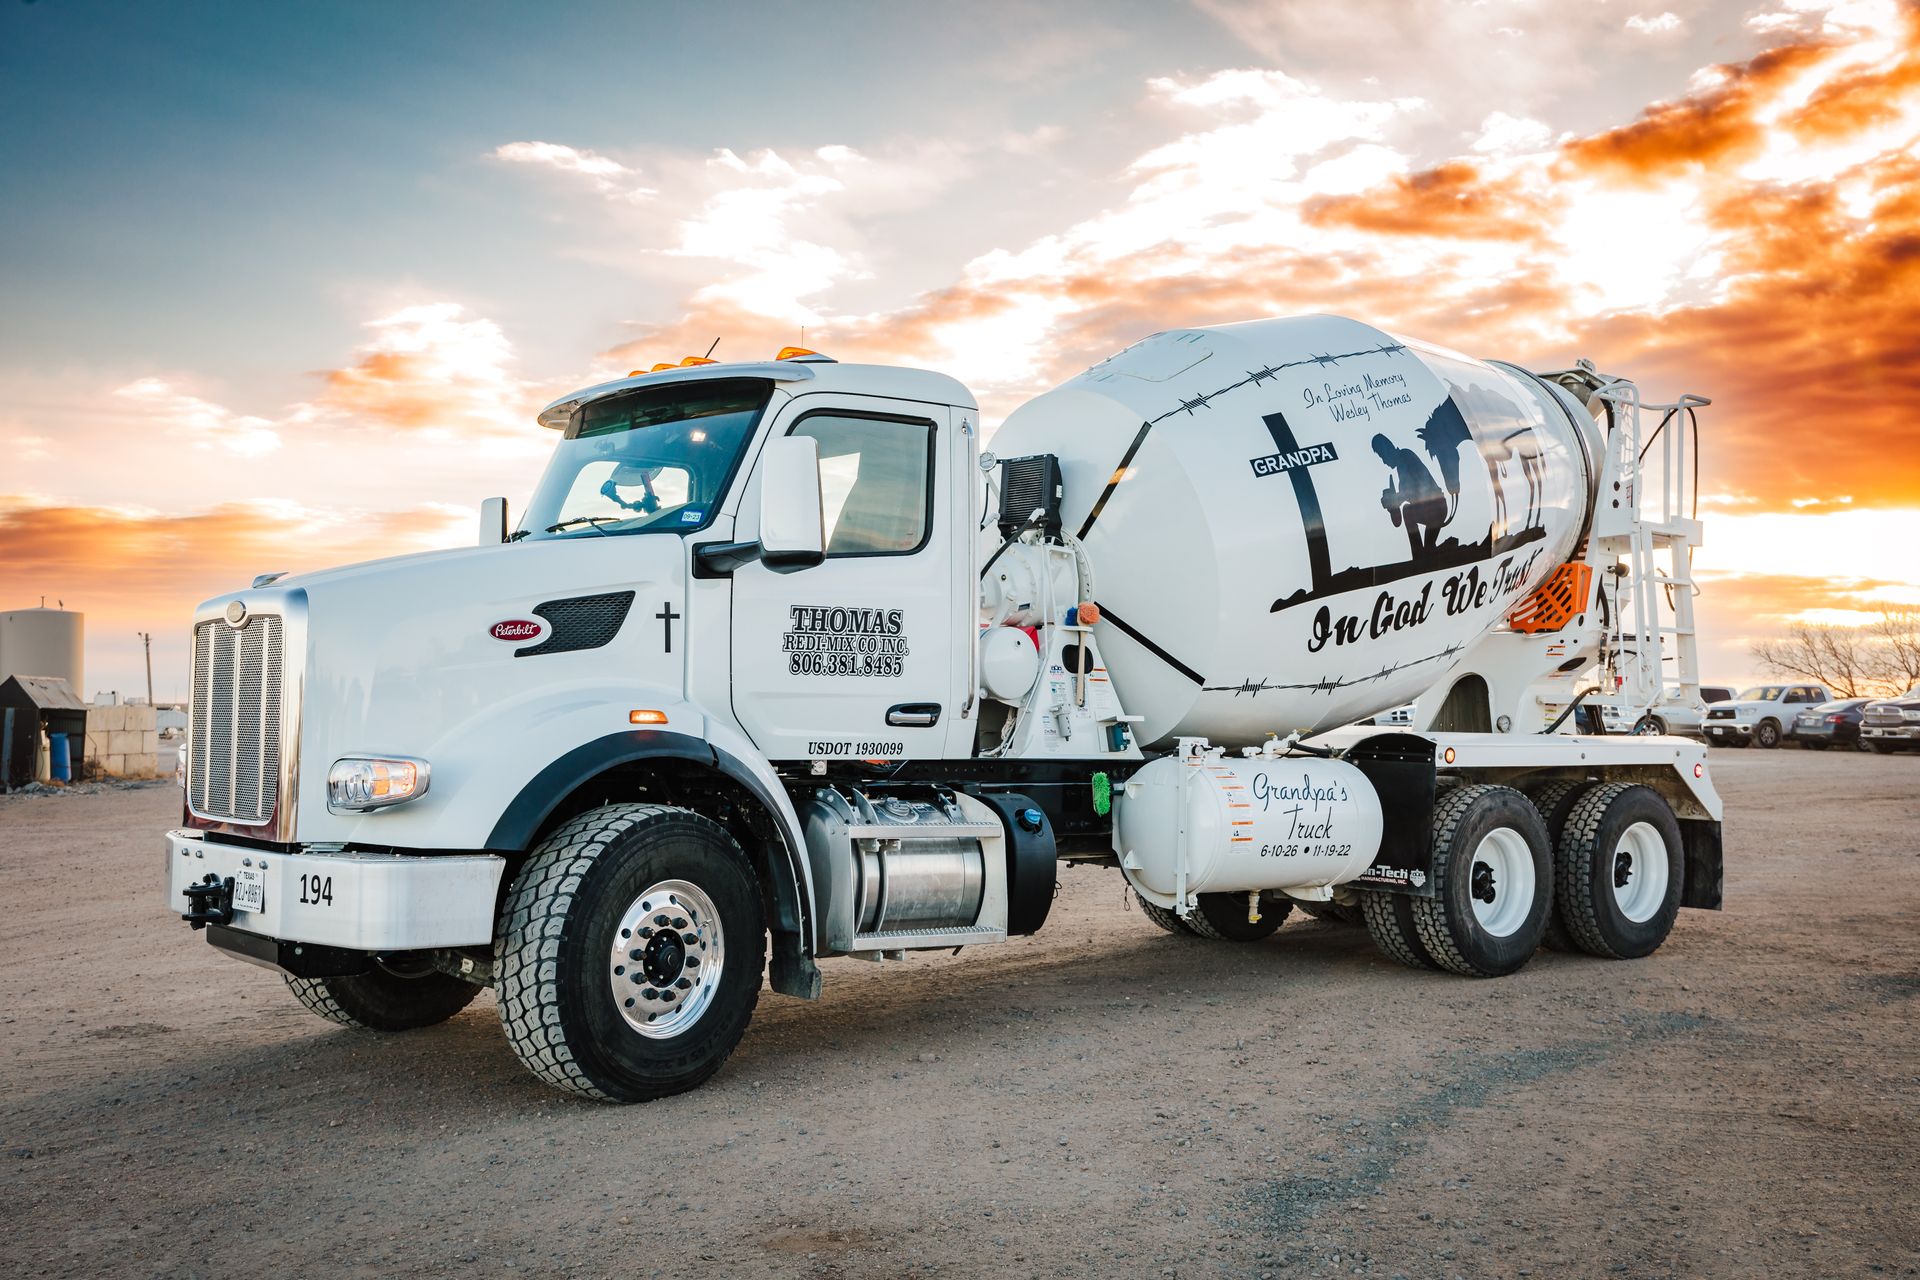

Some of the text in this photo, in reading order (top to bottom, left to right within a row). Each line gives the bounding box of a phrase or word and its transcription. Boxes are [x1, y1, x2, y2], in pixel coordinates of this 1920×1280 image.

[1303, 373, 1407, 409] In Loving Memory
[1329, 392, 1412, 422] Wesley Thomas
[1253, 446, 1334, 474] GRANDPA
[1307, 547, 1544, 653] In God We Trust
[495, 623, 538, 637] Peterbilt
[791, 606, 903, 636] THOMAS
[783, 634, 909, 656] REDI-MIX CO INC.
[789, 652, 904, 677] 806.381.8485
[807, 741, 904, 756] USDOT 1930099
[1252, 772, 1348, 813] Grandpa's
[1282, 803, 1333, 840] Truck
[299, 873, 333, 907] 194
